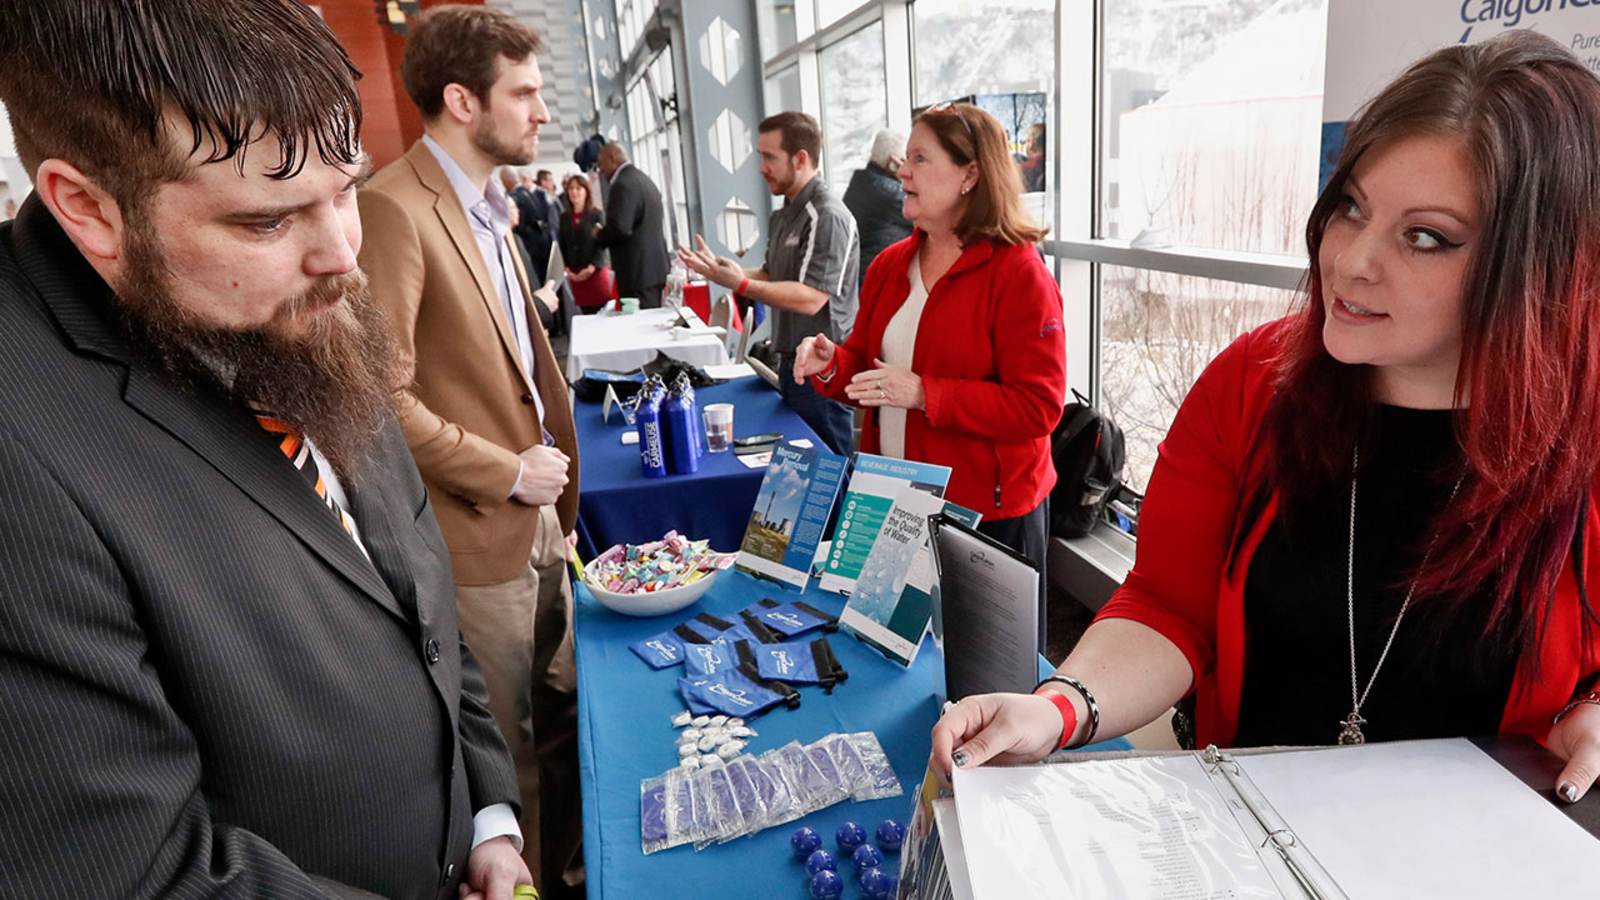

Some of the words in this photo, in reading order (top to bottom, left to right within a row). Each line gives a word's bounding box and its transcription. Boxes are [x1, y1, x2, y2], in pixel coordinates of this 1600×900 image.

[647, 421, 661, 468] CARMEUSE
[777, 447, 803, 462] Mercury
[782, 458, 809, 472] Removal
[860, 459, 889, 471] BEVERAGE
[889, 463, 918, 475] INDUSTRY
[893, 505, 926, 526] Improving
[884, 526, 892, 537] of
[891, 528, 911, 545] Water
[888, 516, 898, 526] the
[899, 518, 924, 539] Quality
